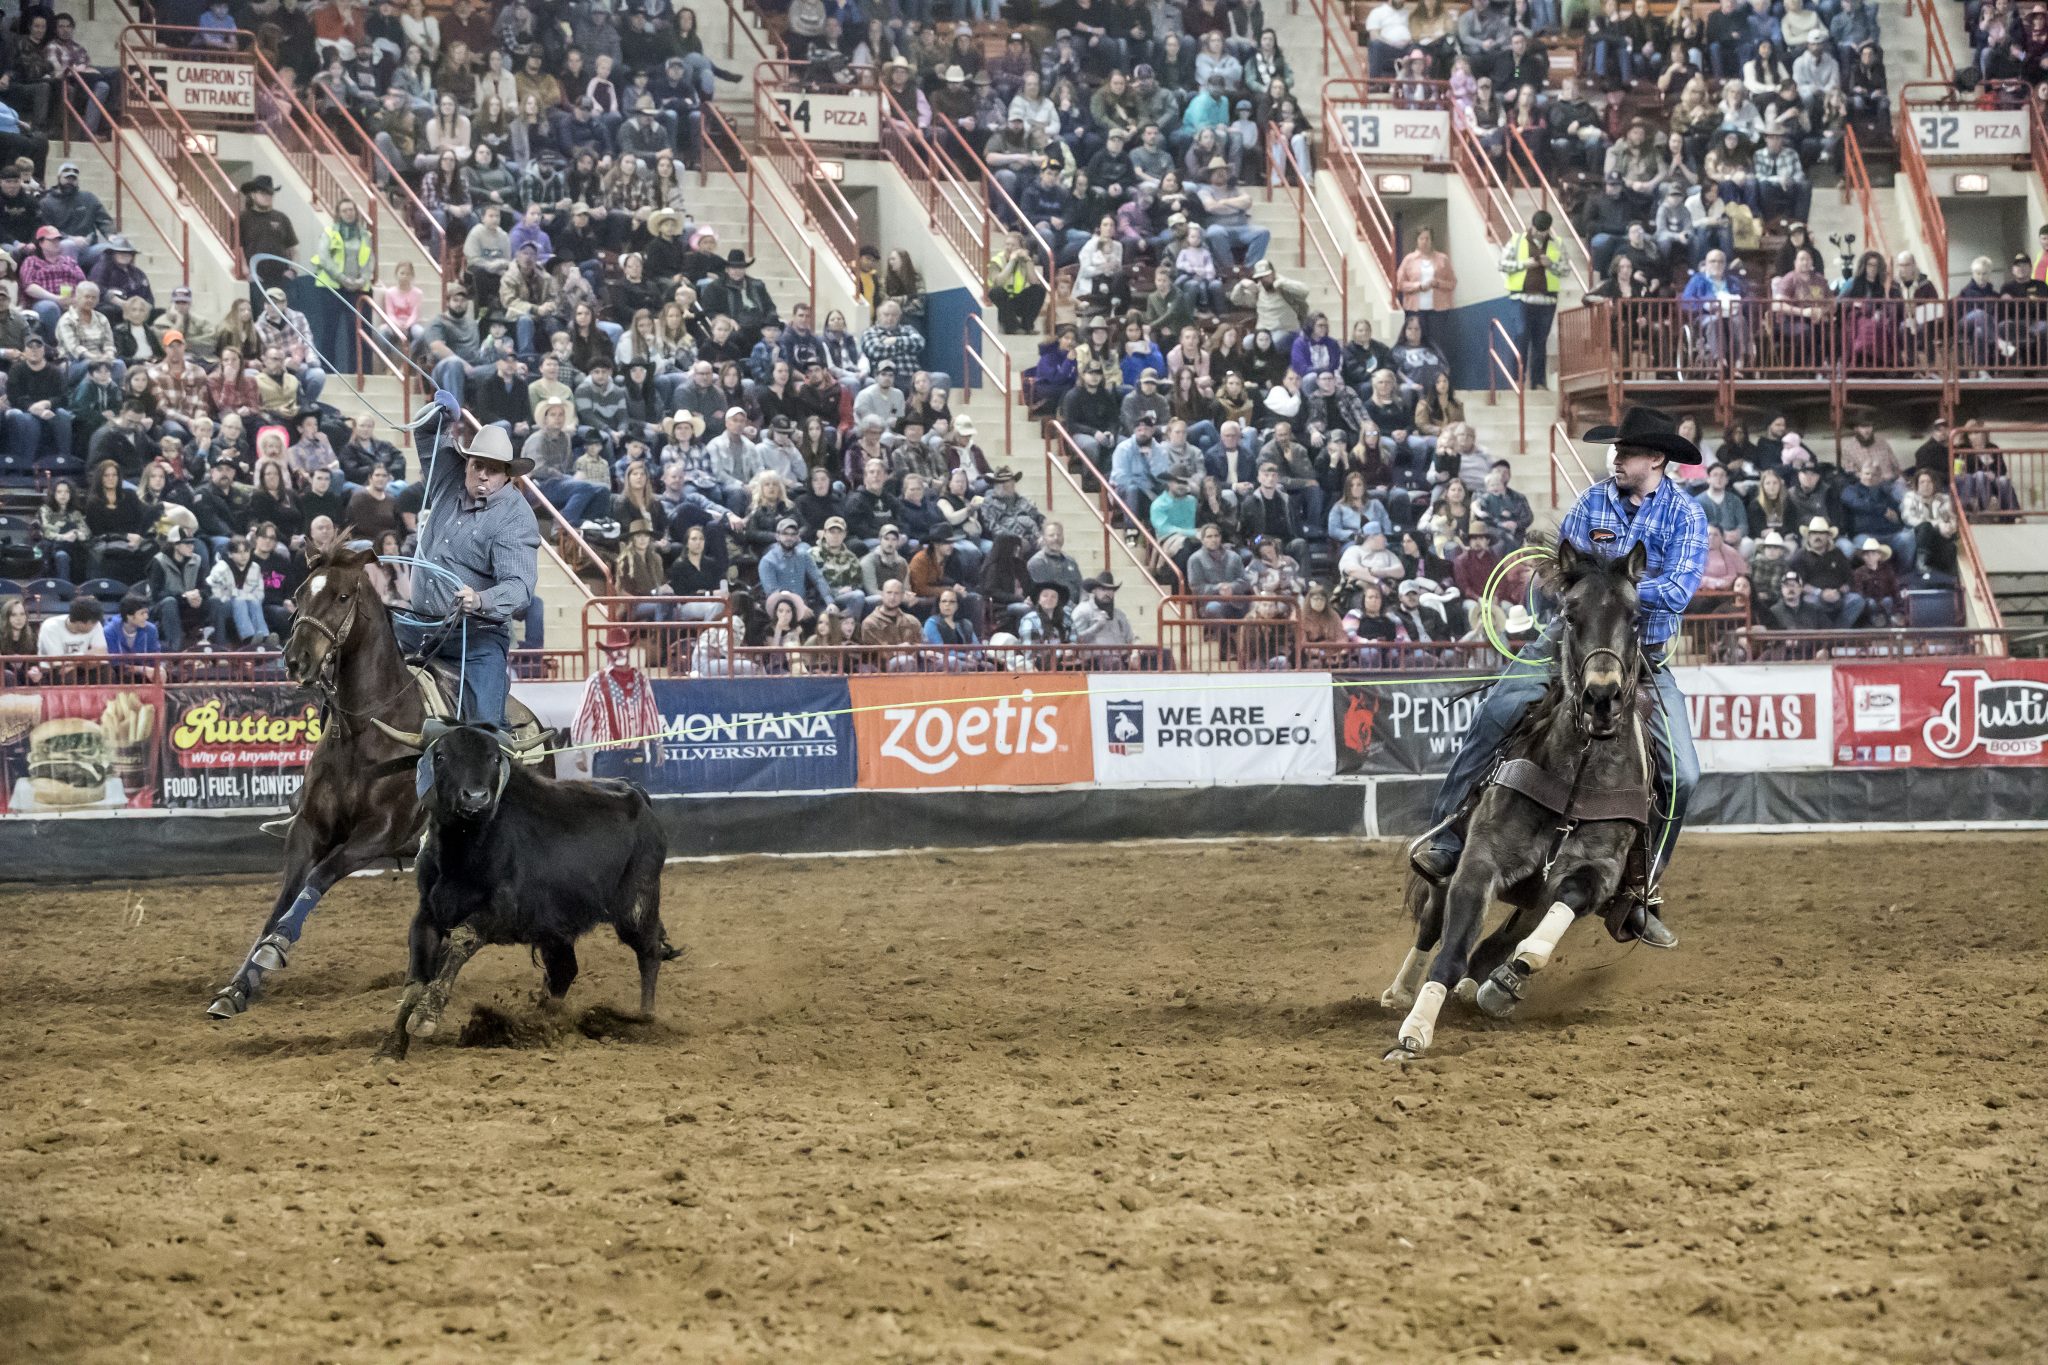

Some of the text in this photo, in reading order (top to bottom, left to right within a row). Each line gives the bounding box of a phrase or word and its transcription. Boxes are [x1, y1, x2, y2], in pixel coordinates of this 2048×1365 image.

[177, 66, 235, 85] CAMERON
[185, 88, 251, 107] ENTRANCE
[774, 98, 868, 133] 34 PIZZA
[1341, 115, 1441, 148] 33 PIZZA
[1919, 117, 2022, 148] 32 PIZZA
[174, 700, 321, 749] Rutter's
[1158, 706, 1264, 725] WE ARE
[1685, 695, 1802, 739] VEGAS
[880, 688, 1059, 774] zoetis
[191, 752, 216, 764] Why
[220, 752, 235, 763] Go
[238, 750, 296, 763] Anywhere
[1990, 741, 2038, 752] BOOTS
[164, 777, 198, 798] FOOD
[209, 776, 240, 797] FUEL
